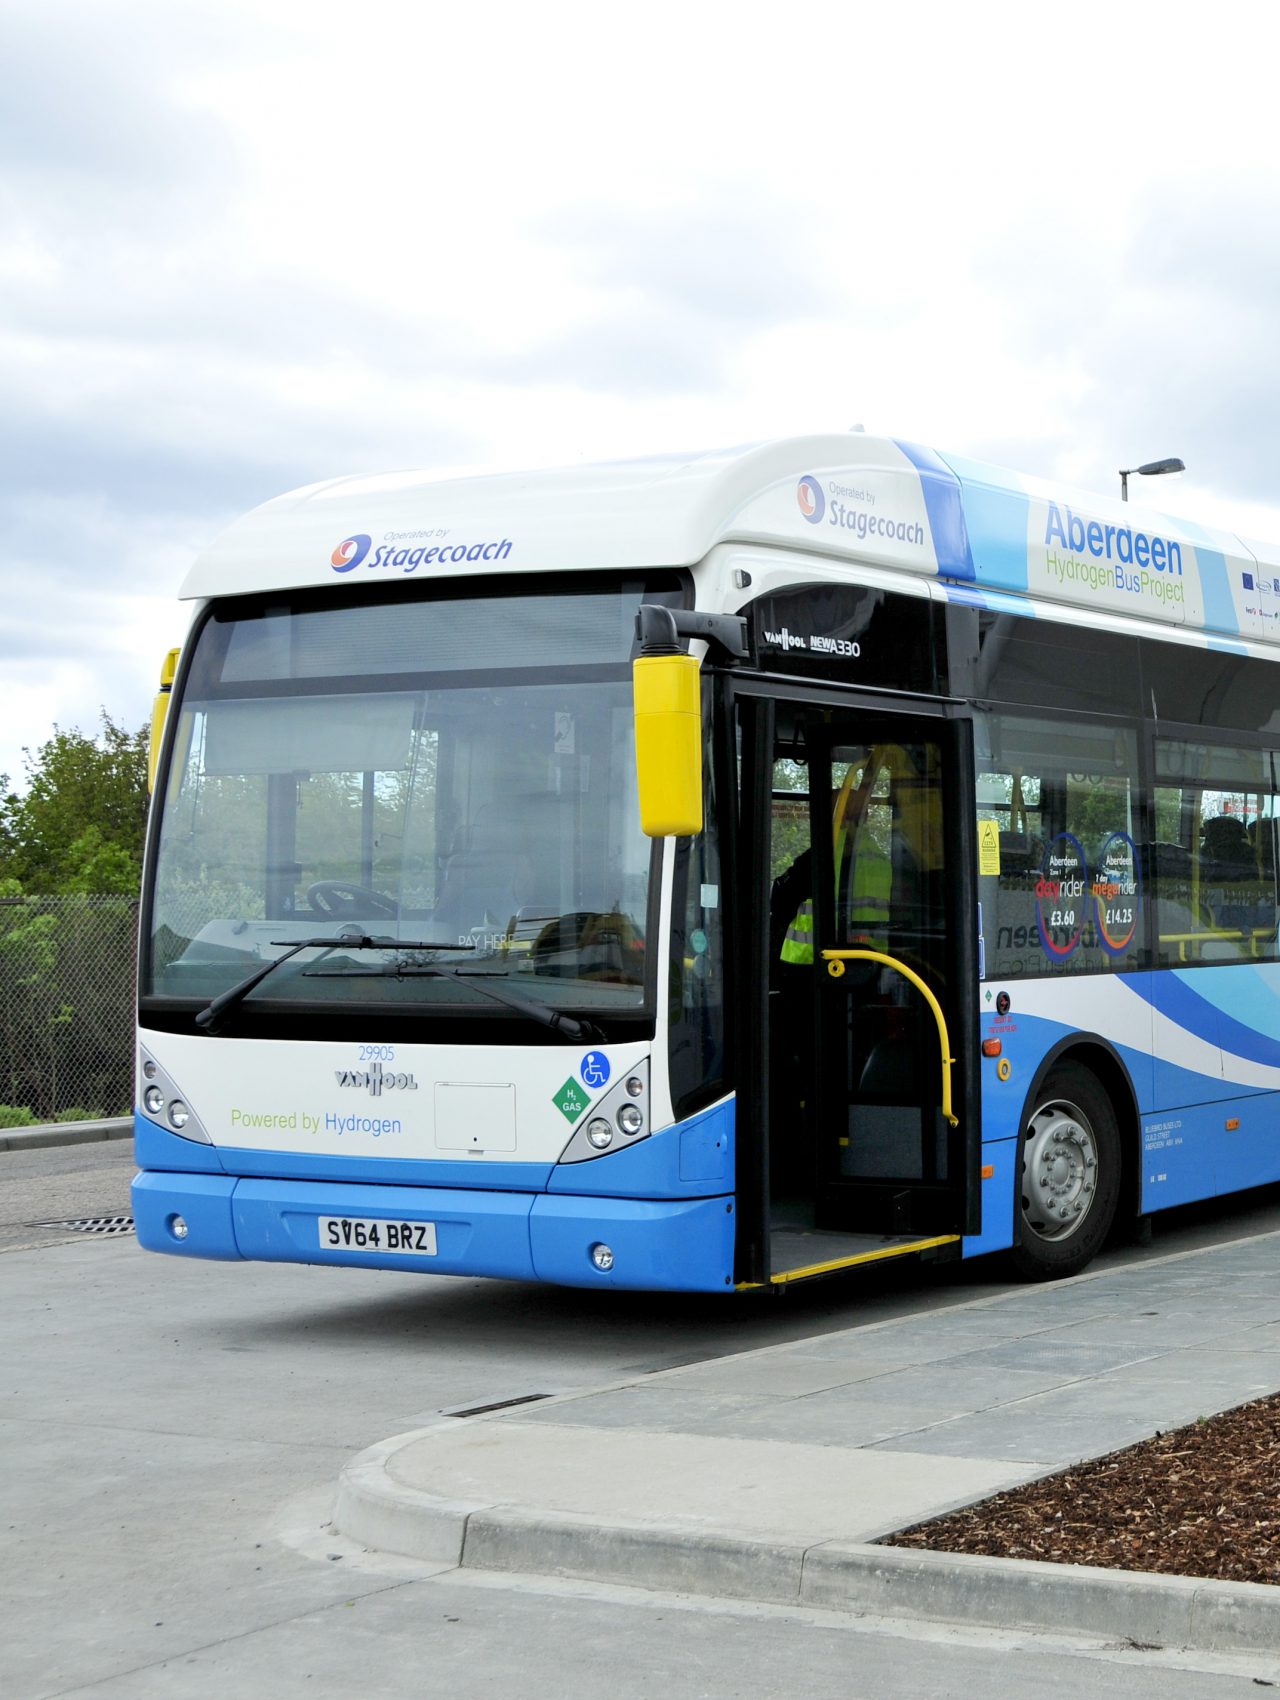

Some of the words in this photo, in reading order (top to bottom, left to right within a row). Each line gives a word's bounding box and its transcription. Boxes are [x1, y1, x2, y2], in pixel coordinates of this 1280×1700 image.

[828, 481, 865, 502] Operated
[866, 491, 876, 506] by
[829, 500, 924, 545] Stagecoach
[383, 530, 434, 541] Operated
[435, 527, 449, 538] by
[1045, 500, 1183, 576] Aberdeen
[368, 538, 512, 573] Stagecoach
[1046, 549, 1185, 605] HydrogenBusProject
[1049, 855, 1078, 867] Aberdeen
[1106, 855, 1133, 867] Aberdeen
[1099, 873, 1108, 884] day
[1036, 875, 1085, 905] dayrider
[1092, 879, 1137, 901] megarider
[1051, 910, 1075, 926] £3.60
[1106, 908, 1133, 924] £14.25
[458, 935, 480, 949] PAY
[358, 1045, 395, 1061] 29905
[562, 1102, 582, 1111] GAS
[231, 1109, 297, 1129] Powered
[302, 1111, 320, 1134] by
[325, 1112, 401, 1137] Hydrogen
[327, 1219, 380, 1248] SV64
[386, 1223, 428, 1251] BRZ
